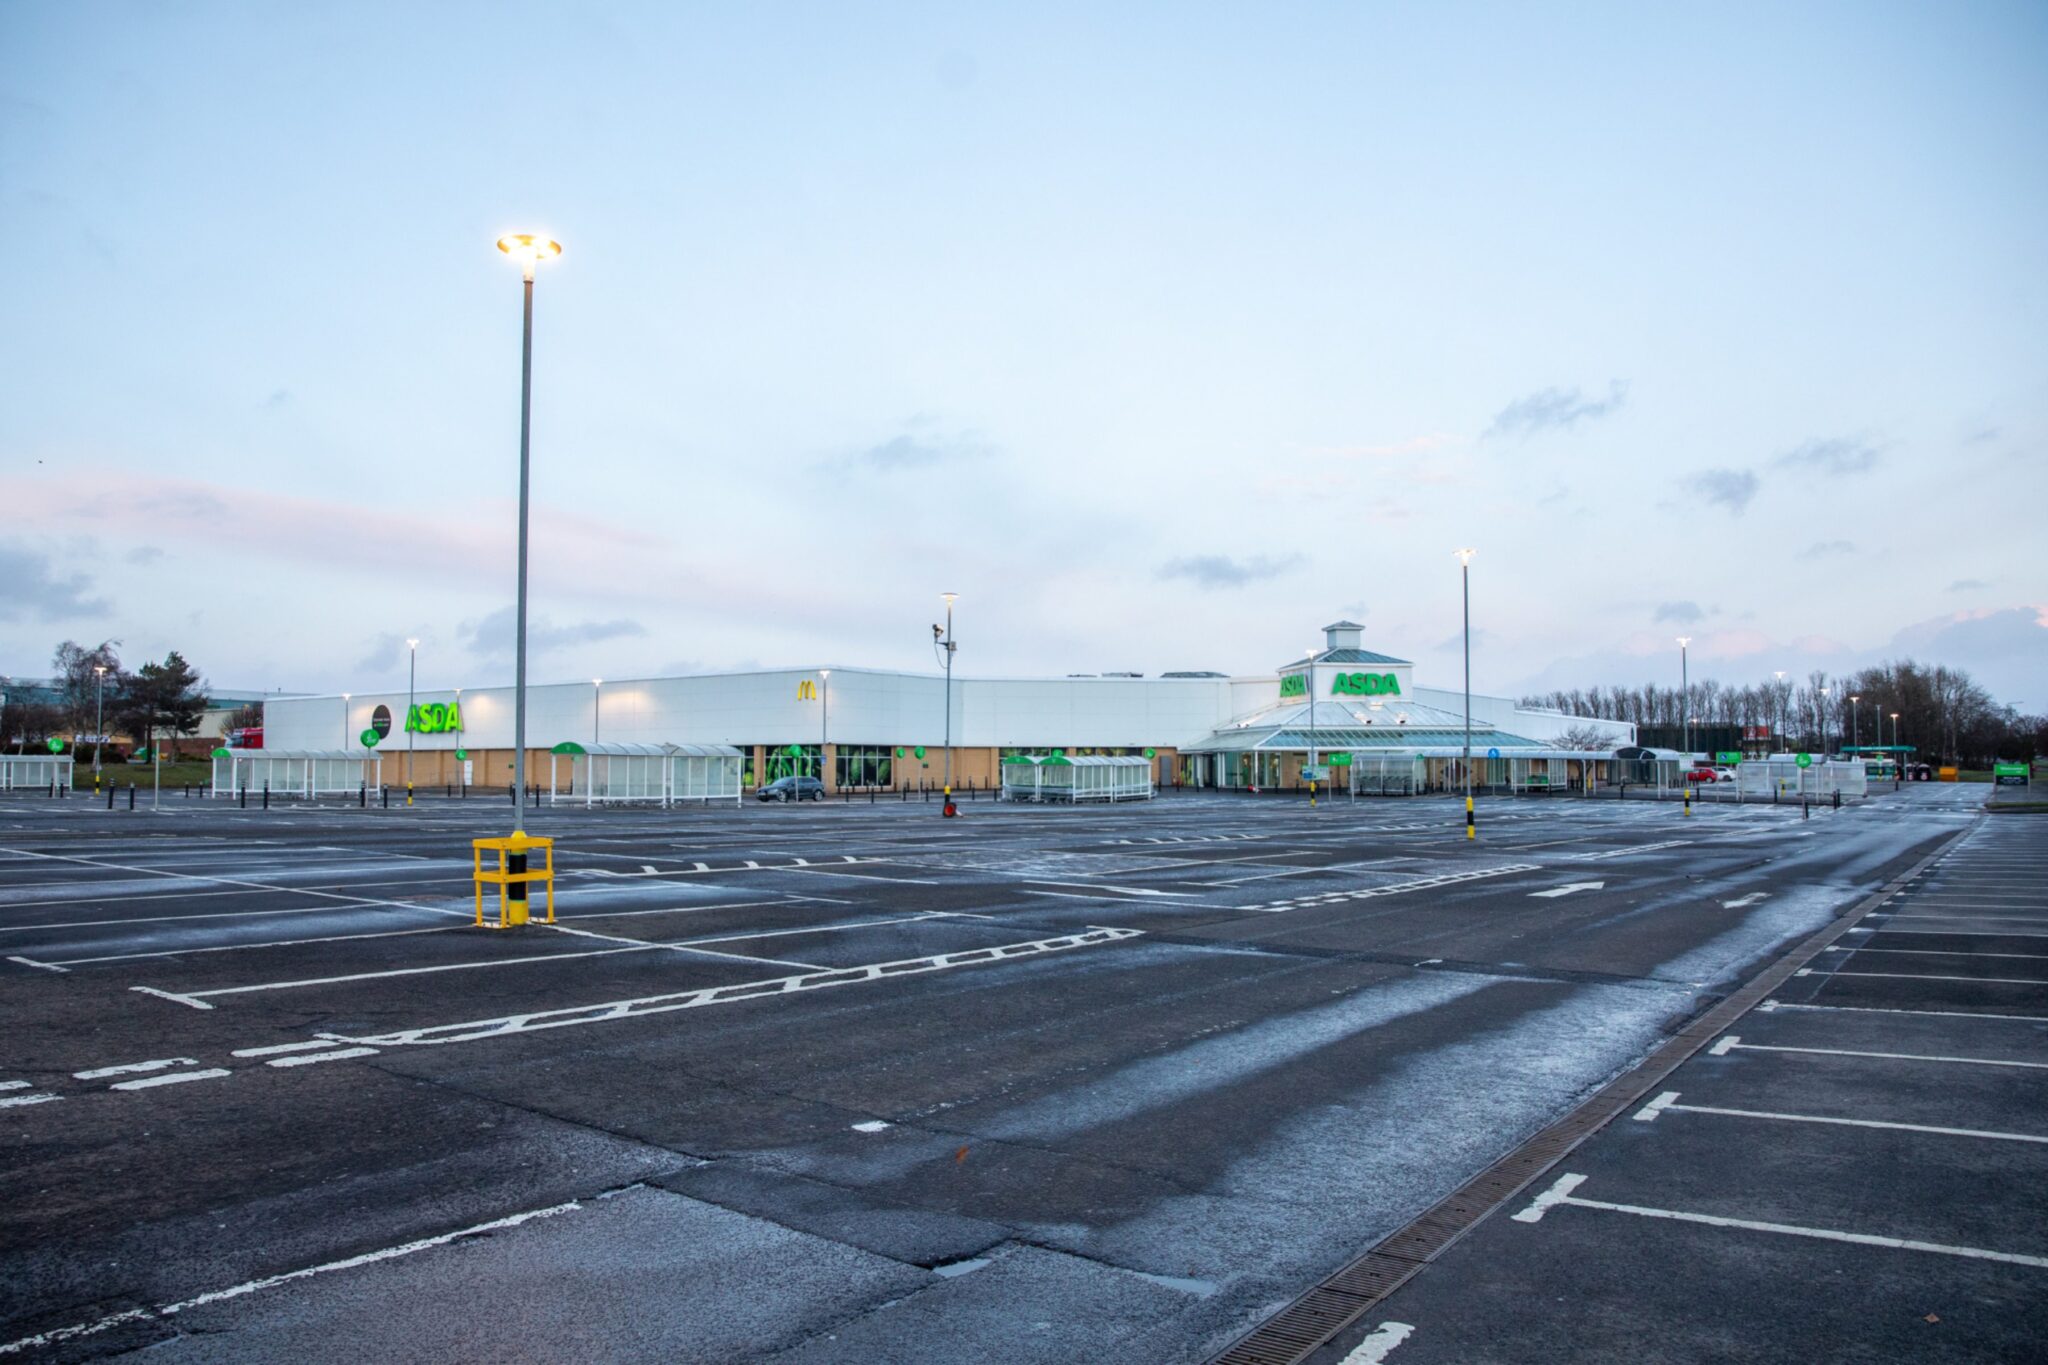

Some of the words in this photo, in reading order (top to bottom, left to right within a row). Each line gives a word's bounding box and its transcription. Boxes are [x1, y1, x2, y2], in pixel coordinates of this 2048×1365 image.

[1280, 674, 1306, 697] ASDA
[1331, 673, 1401, 696] ASDA
[404, 703, 463, 733] ASDA
